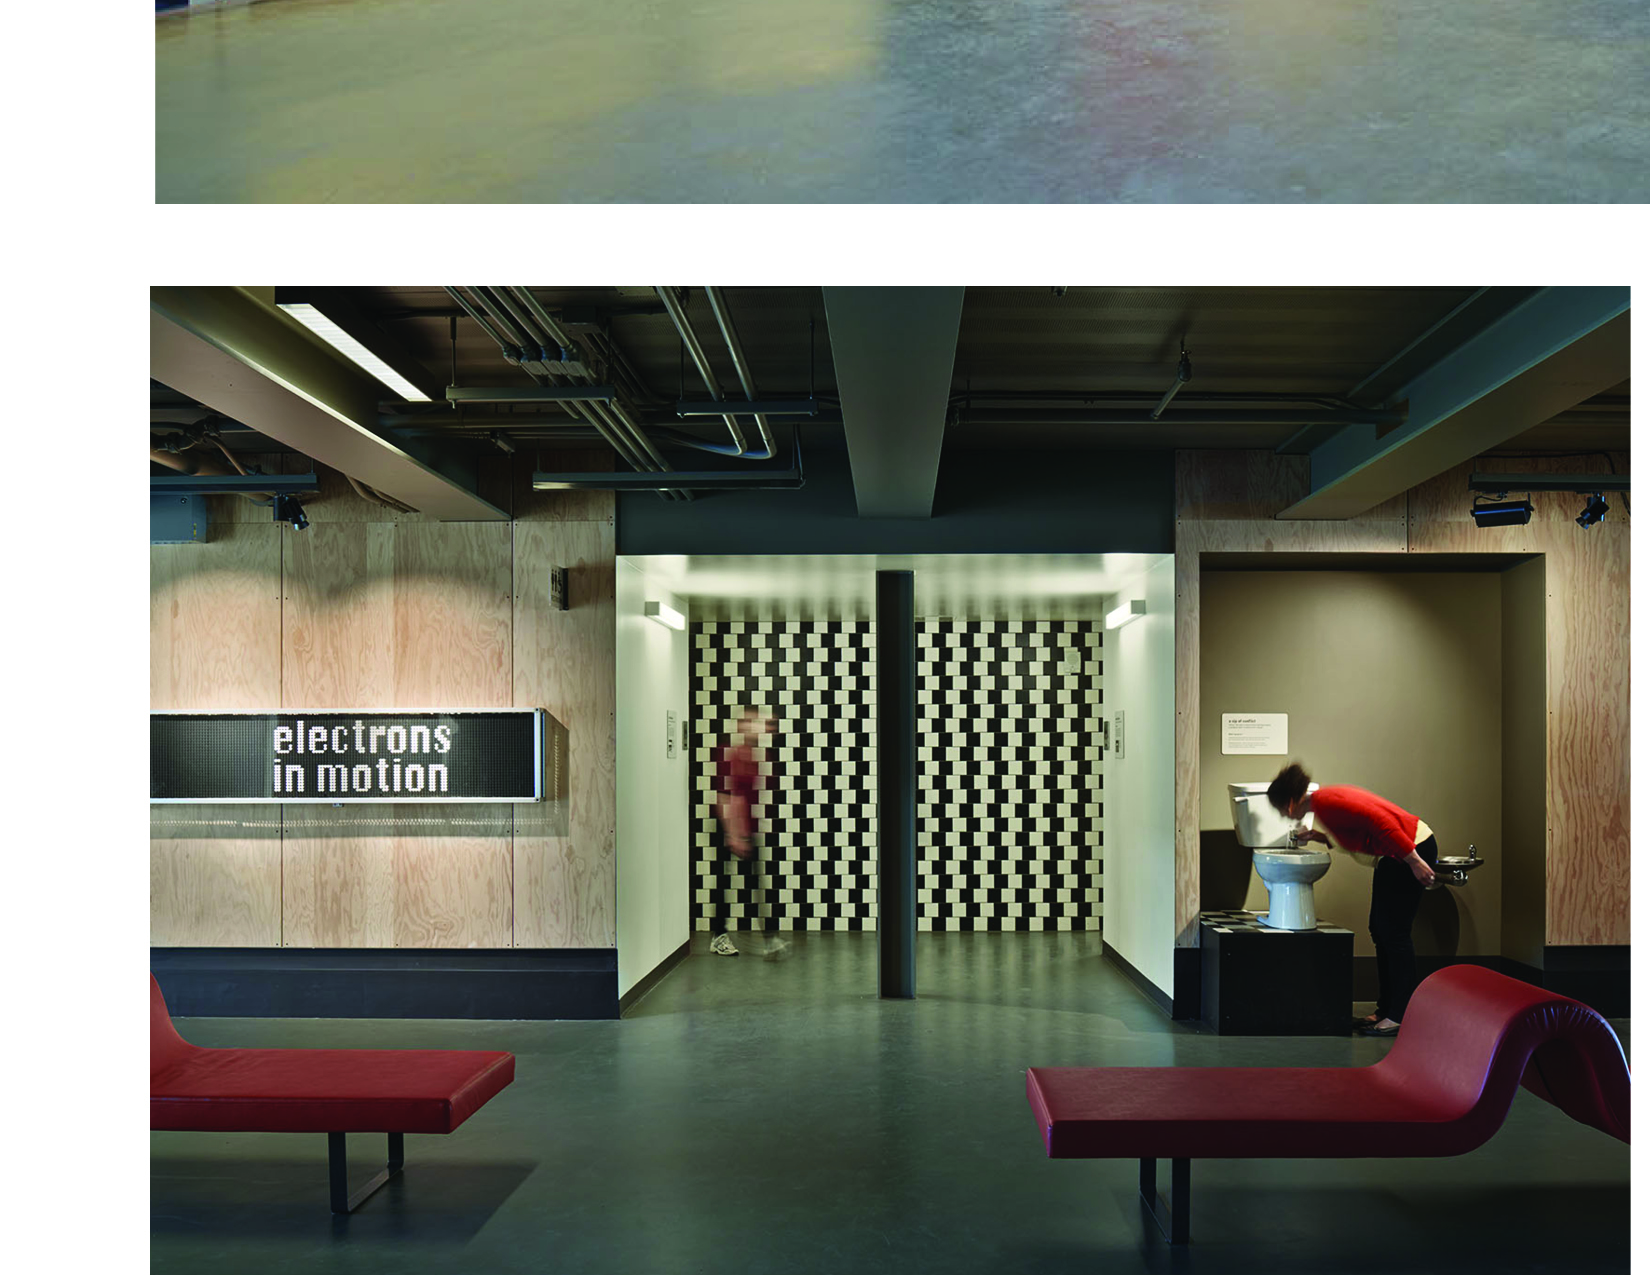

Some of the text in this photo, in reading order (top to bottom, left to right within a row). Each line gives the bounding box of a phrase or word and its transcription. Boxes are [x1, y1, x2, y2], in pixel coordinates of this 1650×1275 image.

[273, 720, 451, 754] electrons
[273, 759, 449, 792] in motion
